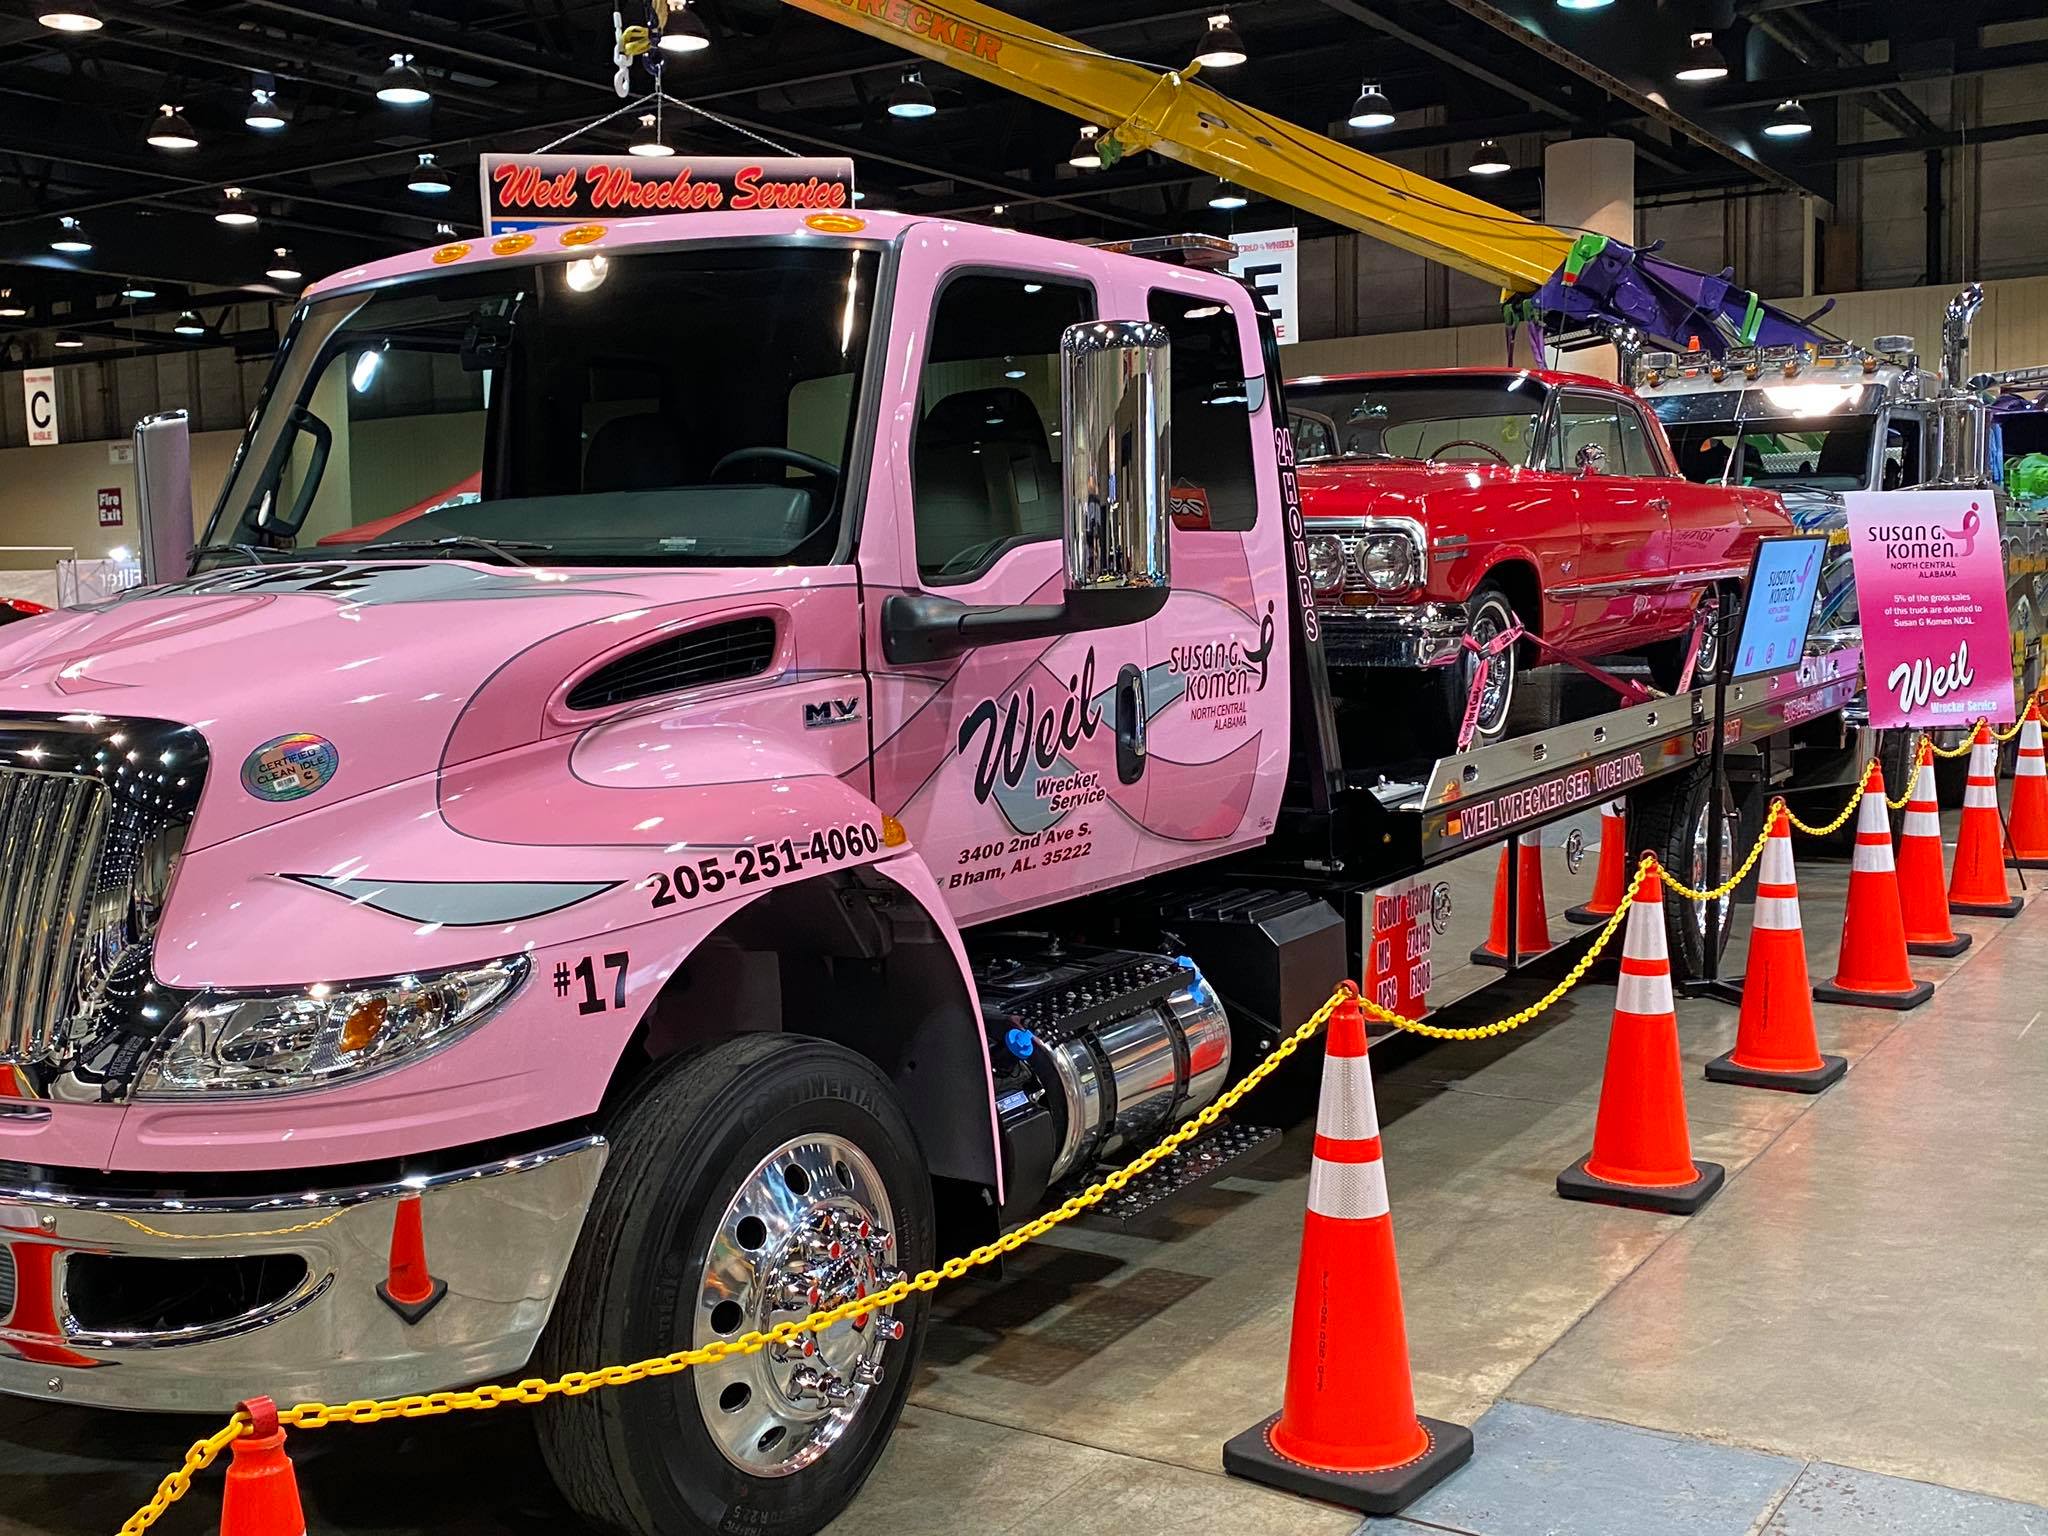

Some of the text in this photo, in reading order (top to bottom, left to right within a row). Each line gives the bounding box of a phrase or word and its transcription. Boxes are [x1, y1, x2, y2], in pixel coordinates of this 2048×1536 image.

[845, 0, 1003, 64] RECKER
[494, 163, 846, 209] Weil Wrecker Service
[31, 391, 51, 428] C
[1274, 427, 1294, 467] 24
[99, 493, 119, 506] Fire
[100, 508, 121, 521] Exit
[1931, 525, 1946, 541] G.
[1283, 472, 1318, 642] HOURS
[1890, 561, 1956, 570] NORTH CENTRAL
[1918, 570, 1957, 579] ALABAMA
[1884, 607, 1892, 615] of
[1894, 606, 1908, 615] this
[1909, 606, 1929, 614] truck
[1943, 605, 1973, 613] donated
[1894, 593, 1971, 604] 5% of the gross sales
[1894, 618, 1918, 627] Susan
[1918, 618, 1925, 626] G
[1926, 617, 1953, 626] Komen
[1229, 641, 1241, 667] G.
[1888, 639, 1975, 713] Weil
[803, 697, 860, 721] MV
[1190, 701, 1247, 720] NORTH CENTRAL
[1931, 700, 1997, 713] Wrecker Service
[957, 645, 1101, 804] Weil
[1214, 715, 1247, 731] ALABAMA
[256, 755, 326, 785] CLEAN IDLE
[258, 749, 316, 773] CERTIFIED
[1036, 772, 1098, 797] Wrecker
[1460, 801, 1498, 840] WEIL
[1499, 778, 1566, 826] WRECKER
[1621, 752, 1645, 783] INC.
[1050, 788, 1106, 812] Service
[957, 822, 1092, 865] 3400 2nd Ave S.
[647, 822, 879, 909] 205-251-4060
[949, 842, 1092, 890] Bham, AL. 35222
[1376, 895, 1402, 933] USDOT
[1376, 938, 1391, 975] MC
[554, 951, 629, 1015] #17
